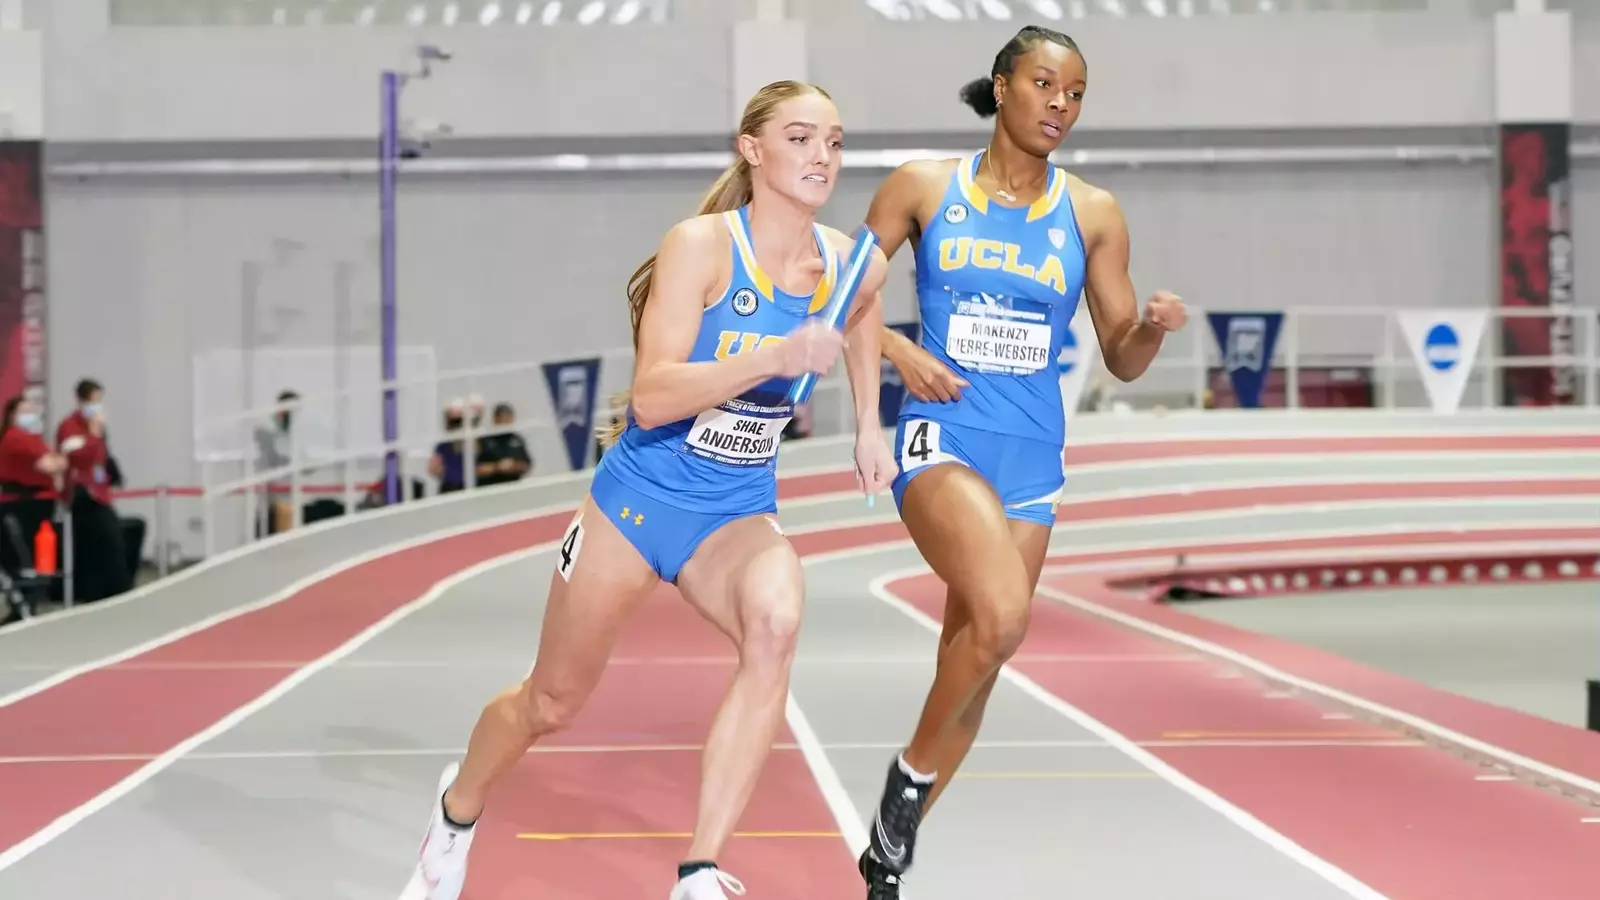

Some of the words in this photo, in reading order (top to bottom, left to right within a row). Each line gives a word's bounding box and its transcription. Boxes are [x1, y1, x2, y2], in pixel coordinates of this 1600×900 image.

[939, 237, 1067, 296] UCLA
[972, 323, 1029, 341] MAKENZY
[698, 428, 774, 454] ANDERSON
[733, 420, 766, 436] SHAE
[908, 422, 933, 461] 4
[561, 524, 580, 572] 4
